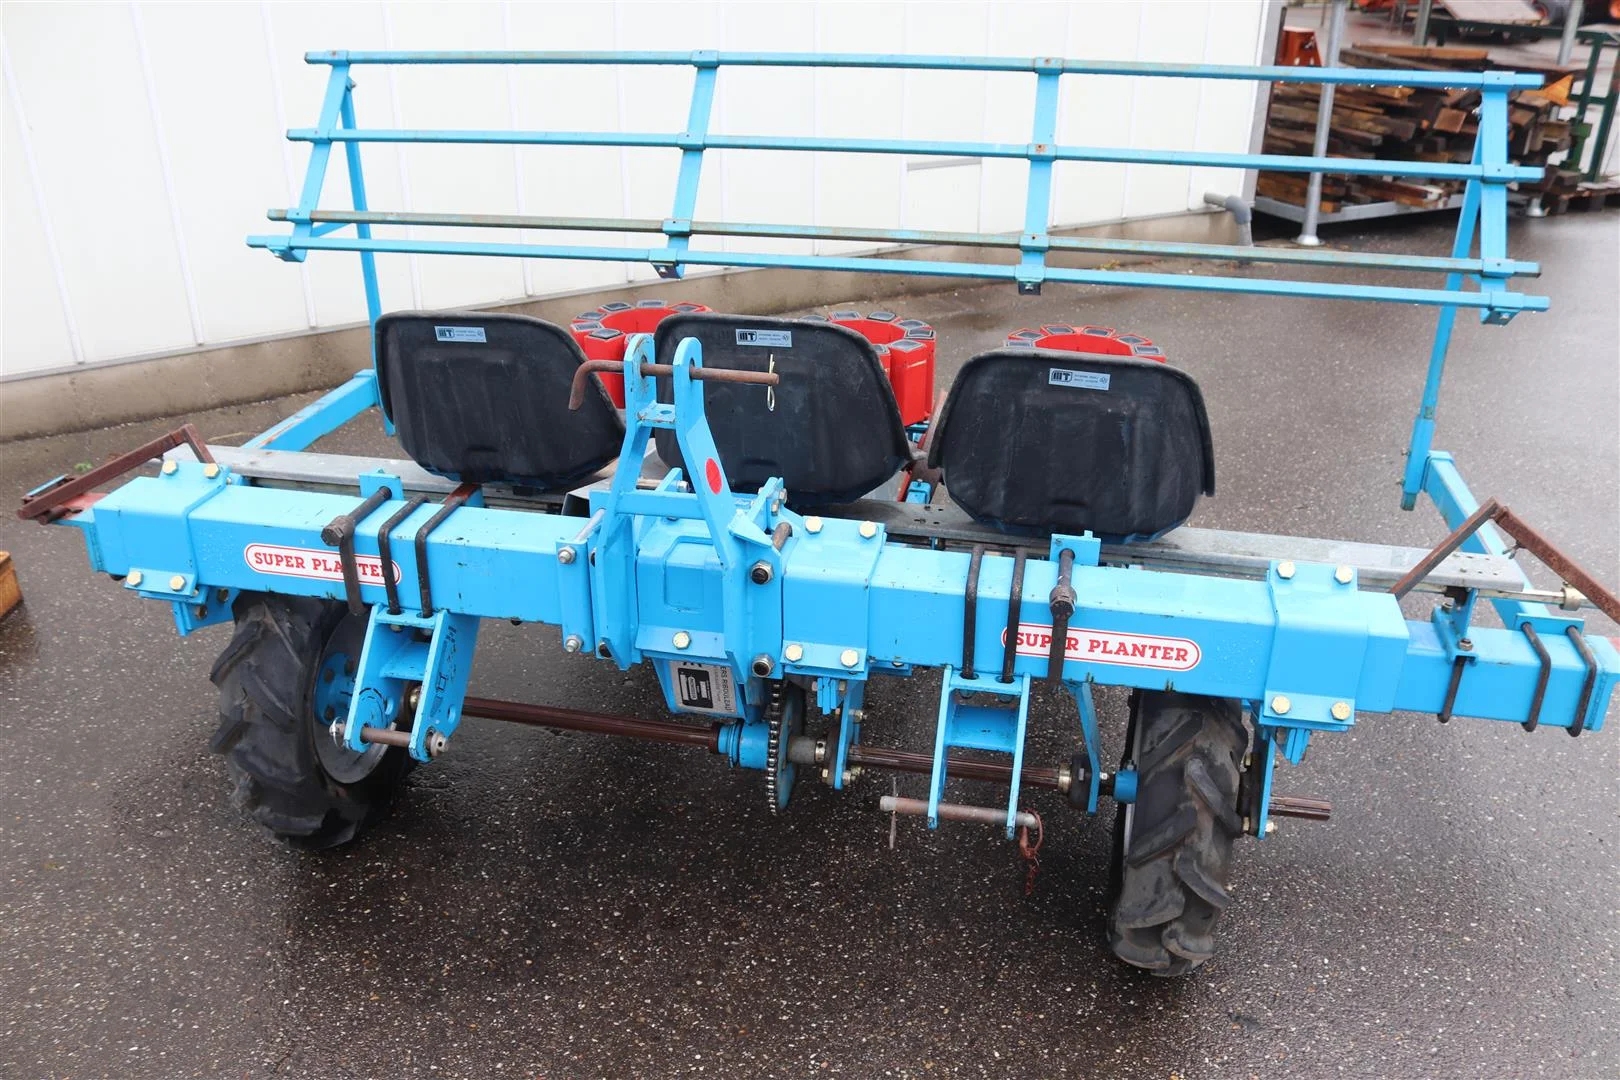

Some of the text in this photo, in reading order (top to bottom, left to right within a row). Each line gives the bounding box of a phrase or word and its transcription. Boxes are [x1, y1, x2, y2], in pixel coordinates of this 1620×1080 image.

[254, 551, 389, 578] SUPER PLATE
[1016, 631, 1190, 663] SUPR PLANTER
